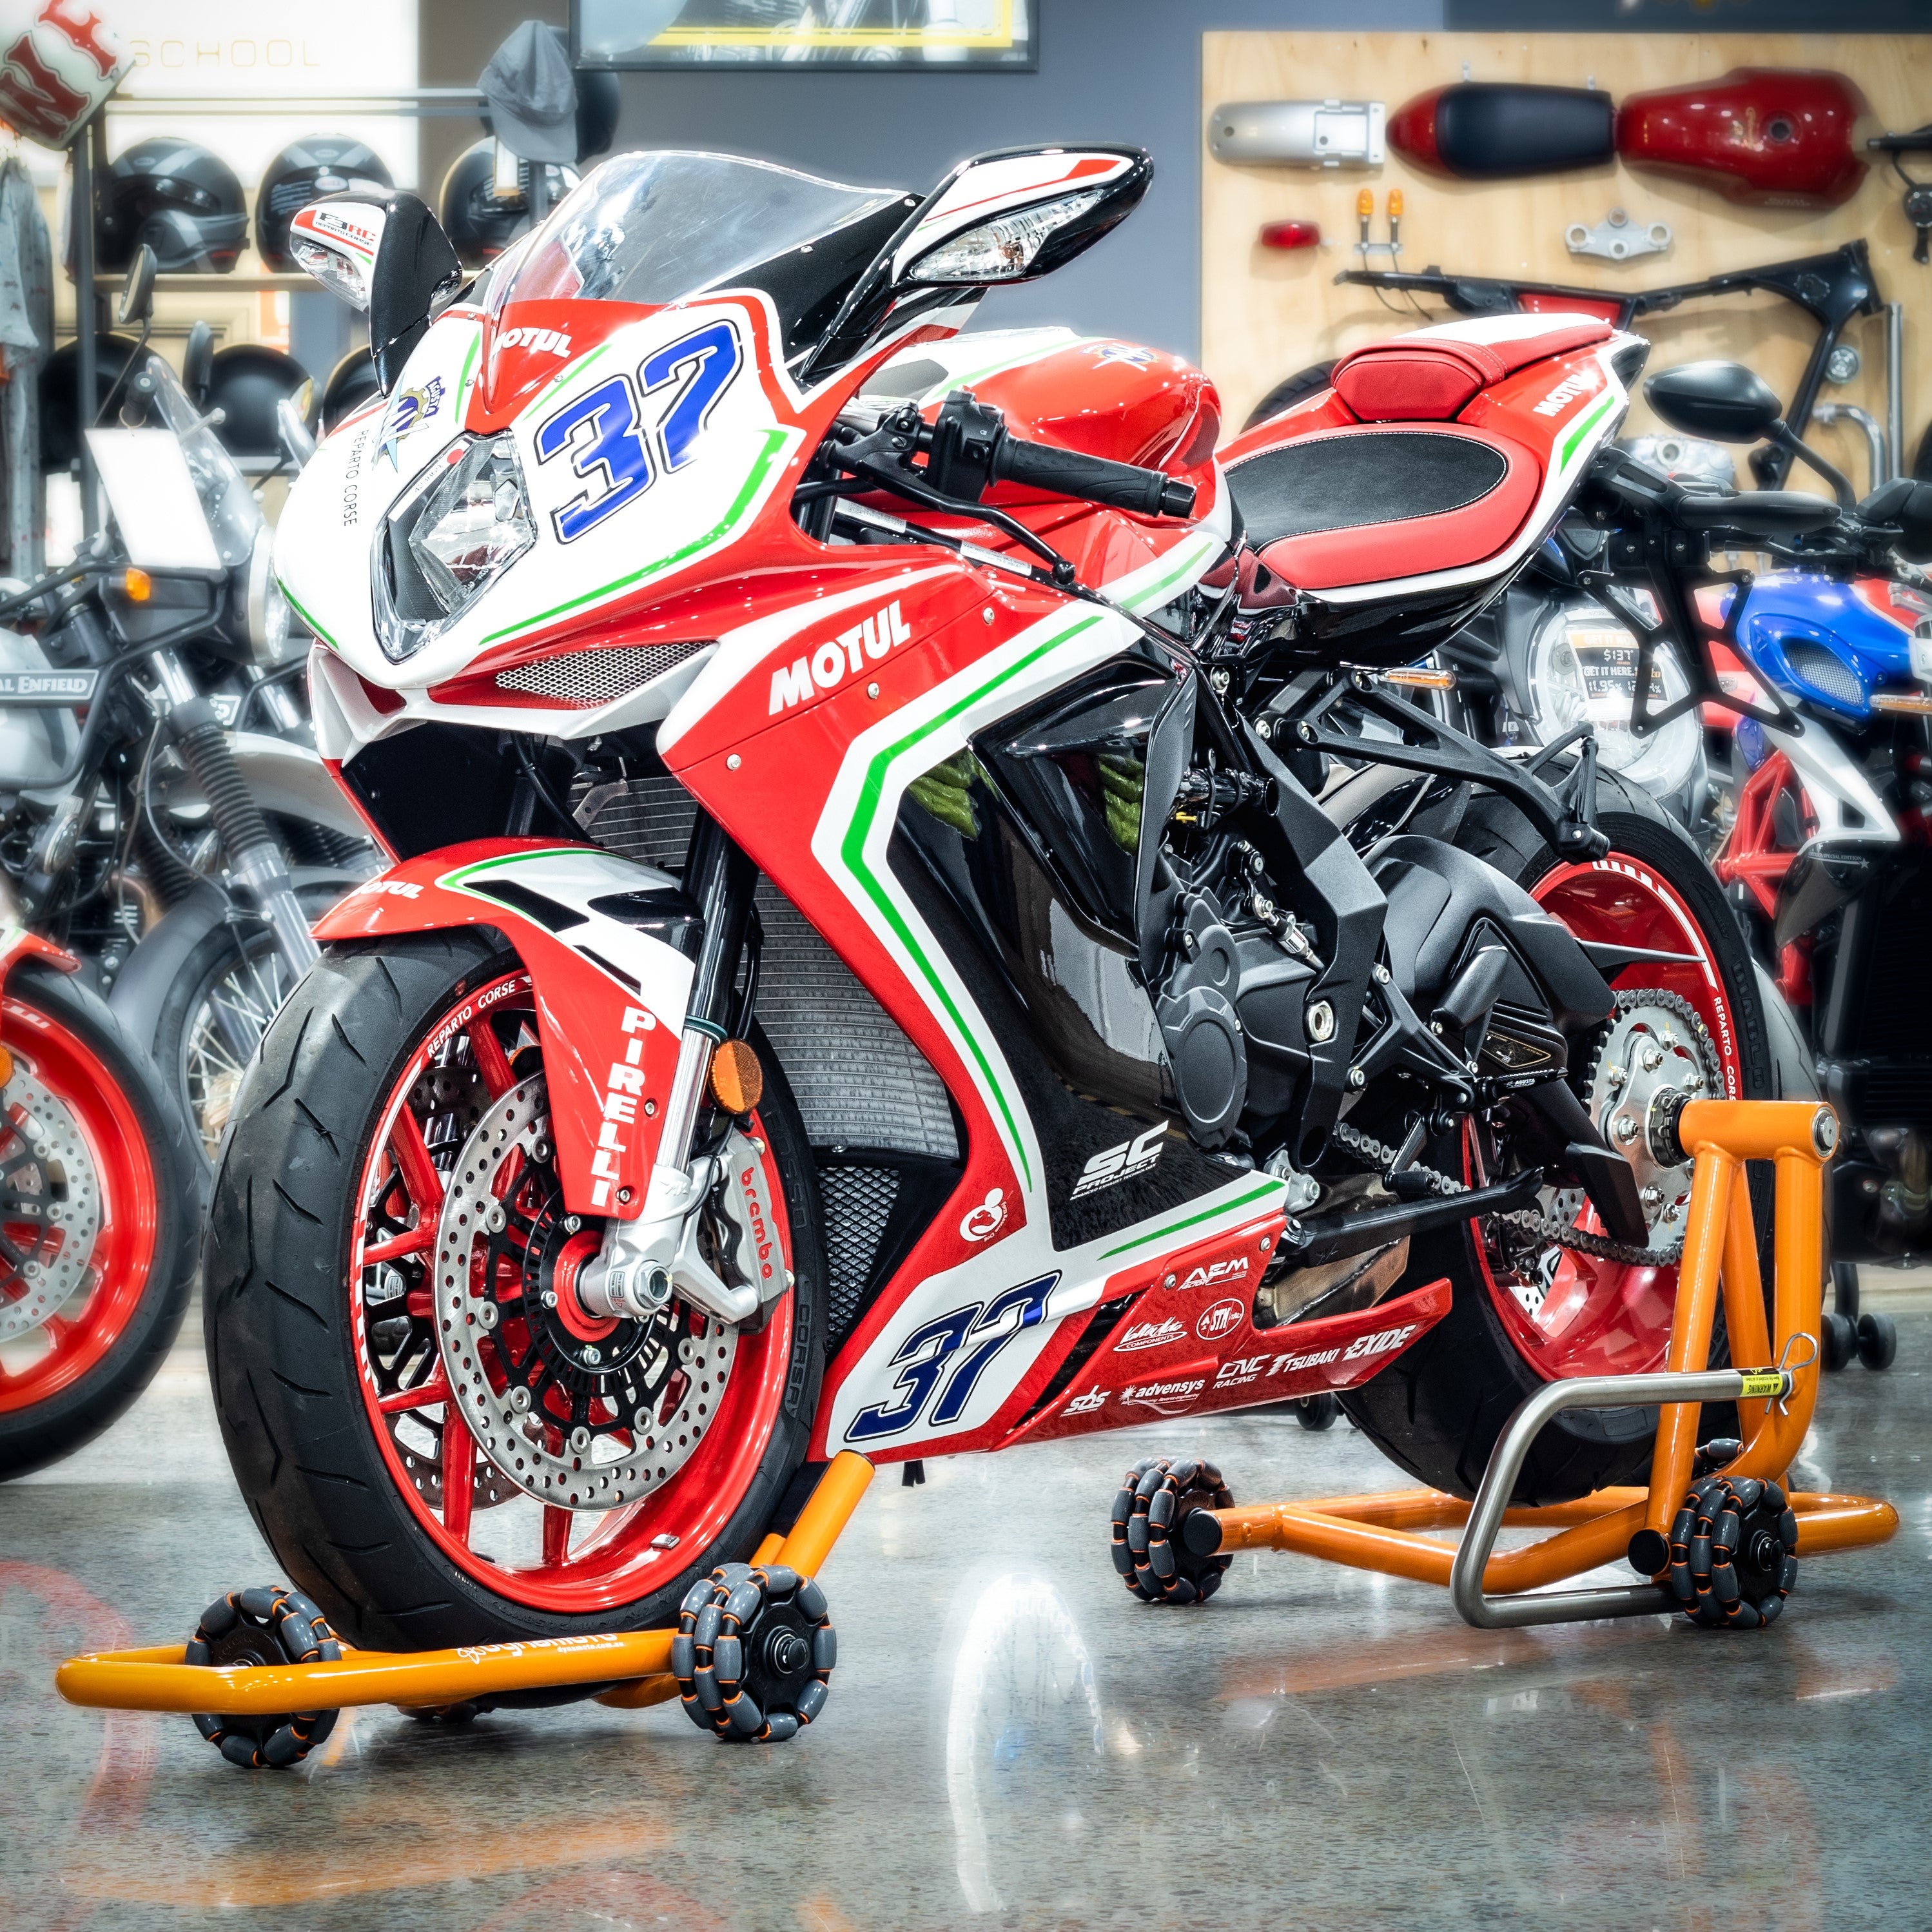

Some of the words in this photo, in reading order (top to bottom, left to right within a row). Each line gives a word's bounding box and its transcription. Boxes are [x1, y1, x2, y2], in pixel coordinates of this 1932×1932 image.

[129, 39, 321, 68] SCHOOL
[422, 379, 442, 418] AGUSTA
[533, 318, 744, 545] 37
[346, 429, 369, 479] REPARTO
[344, 485, 358, 527] CORSE
[1616, 634, 1636, 645] NO
[768, 599, 912, 716] MOTUL
[1583, 666, 1599, 677] GET
[1601, 666, 1609, 676] IT
[17, 676, 88, 694] ENFIELD
[349, 881, 425, 899] OTUL
[426, 1005, 473, 1059] REPARTO
[477, 979, 516, 1010] CORSE
[1713, 997, 1732, 1057] REPARTO
[1726, 1065, 1737, 1101] CORS
[590, 1005, 657, 1208] PIRELLI
[1076, 1120, 1169, 1187] SC
[1072, 1153, 1160, 1195] PROJECT
[1184, 1256, 1249, 1283] AEM
[785, 1303, 811, 1405] CORSA
[843, 1269, 1062, 1443] 37
[1126, 1334, 1175, 1349] COMPONENTS
[1342, 1324, 1417, 1361] EXIDE
[1216, 1354, 1272, 1380] CNC
[1283, 1348, 1340, 1373] TSUBAKI
[1135, 1379, 1205, 1398] advensys
[1212, 1374, 1257, 1389] RACING
[1746, 1383, 1772, 1394] WARNING
[1064, 1385, 1111, 1413] sbs
[556, 1641, 625, 1654] dynamoto.com.au
